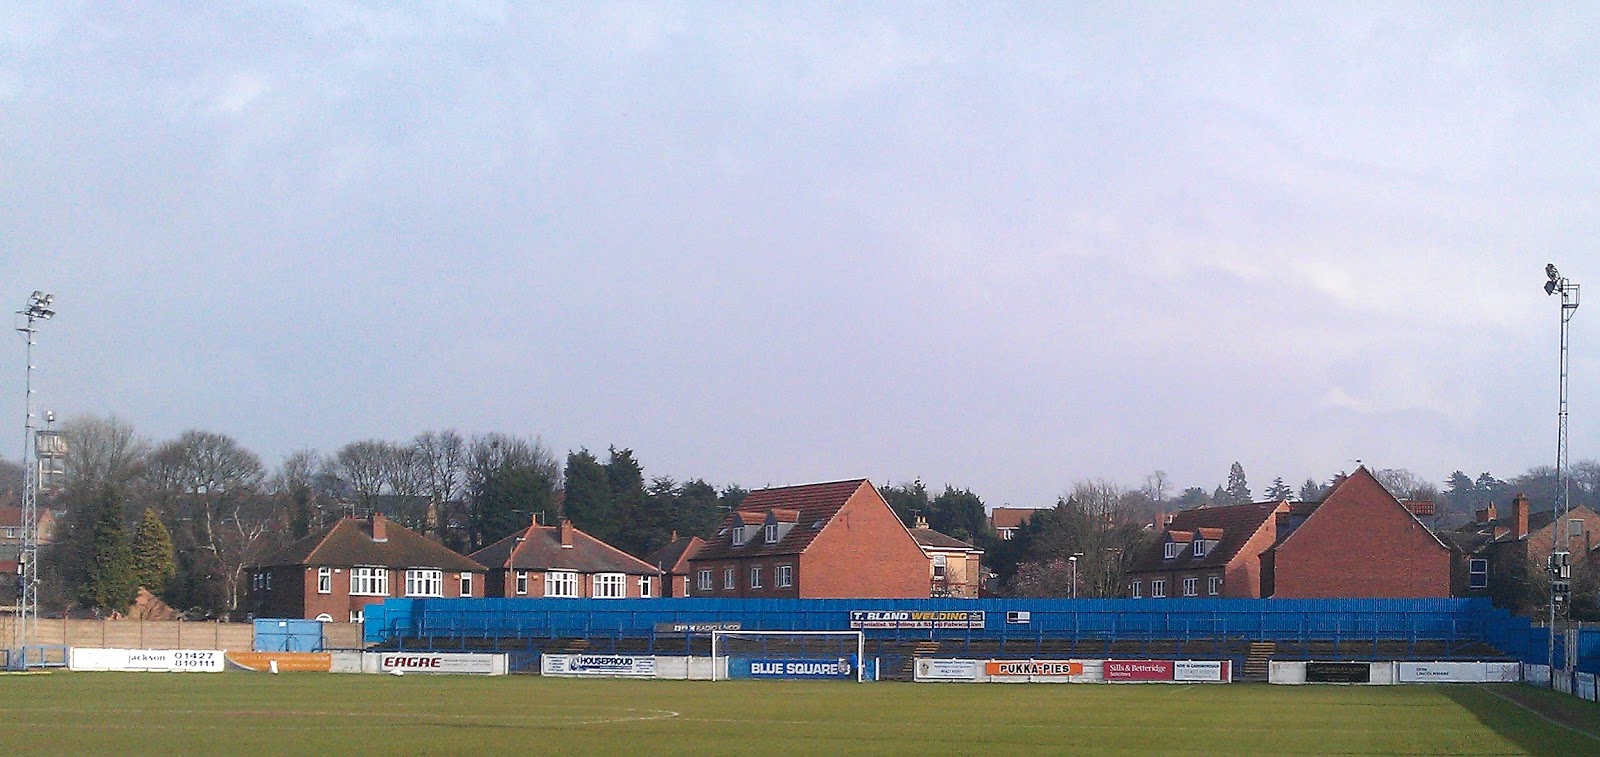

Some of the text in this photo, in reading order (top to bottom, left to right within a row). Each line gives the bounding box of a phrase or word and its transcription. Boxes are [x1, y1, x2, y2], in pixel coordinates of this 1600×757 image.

[853, 612, 864, 620] T.
[867, 612, 908, 620] BLAND
[911, 612, 967, 620] WELDING
[174, 652, 213, 660] 01427
[580, 657, 633, 666] HOUSEPROUD
[751, 663, 784, 674] BLUE
[786, 663, 838, 675] SQUARE
[1000, 663, 1070, 674] PUKKA-PIES
[1109, 664, 1166, 673] Sills & Betteridge
